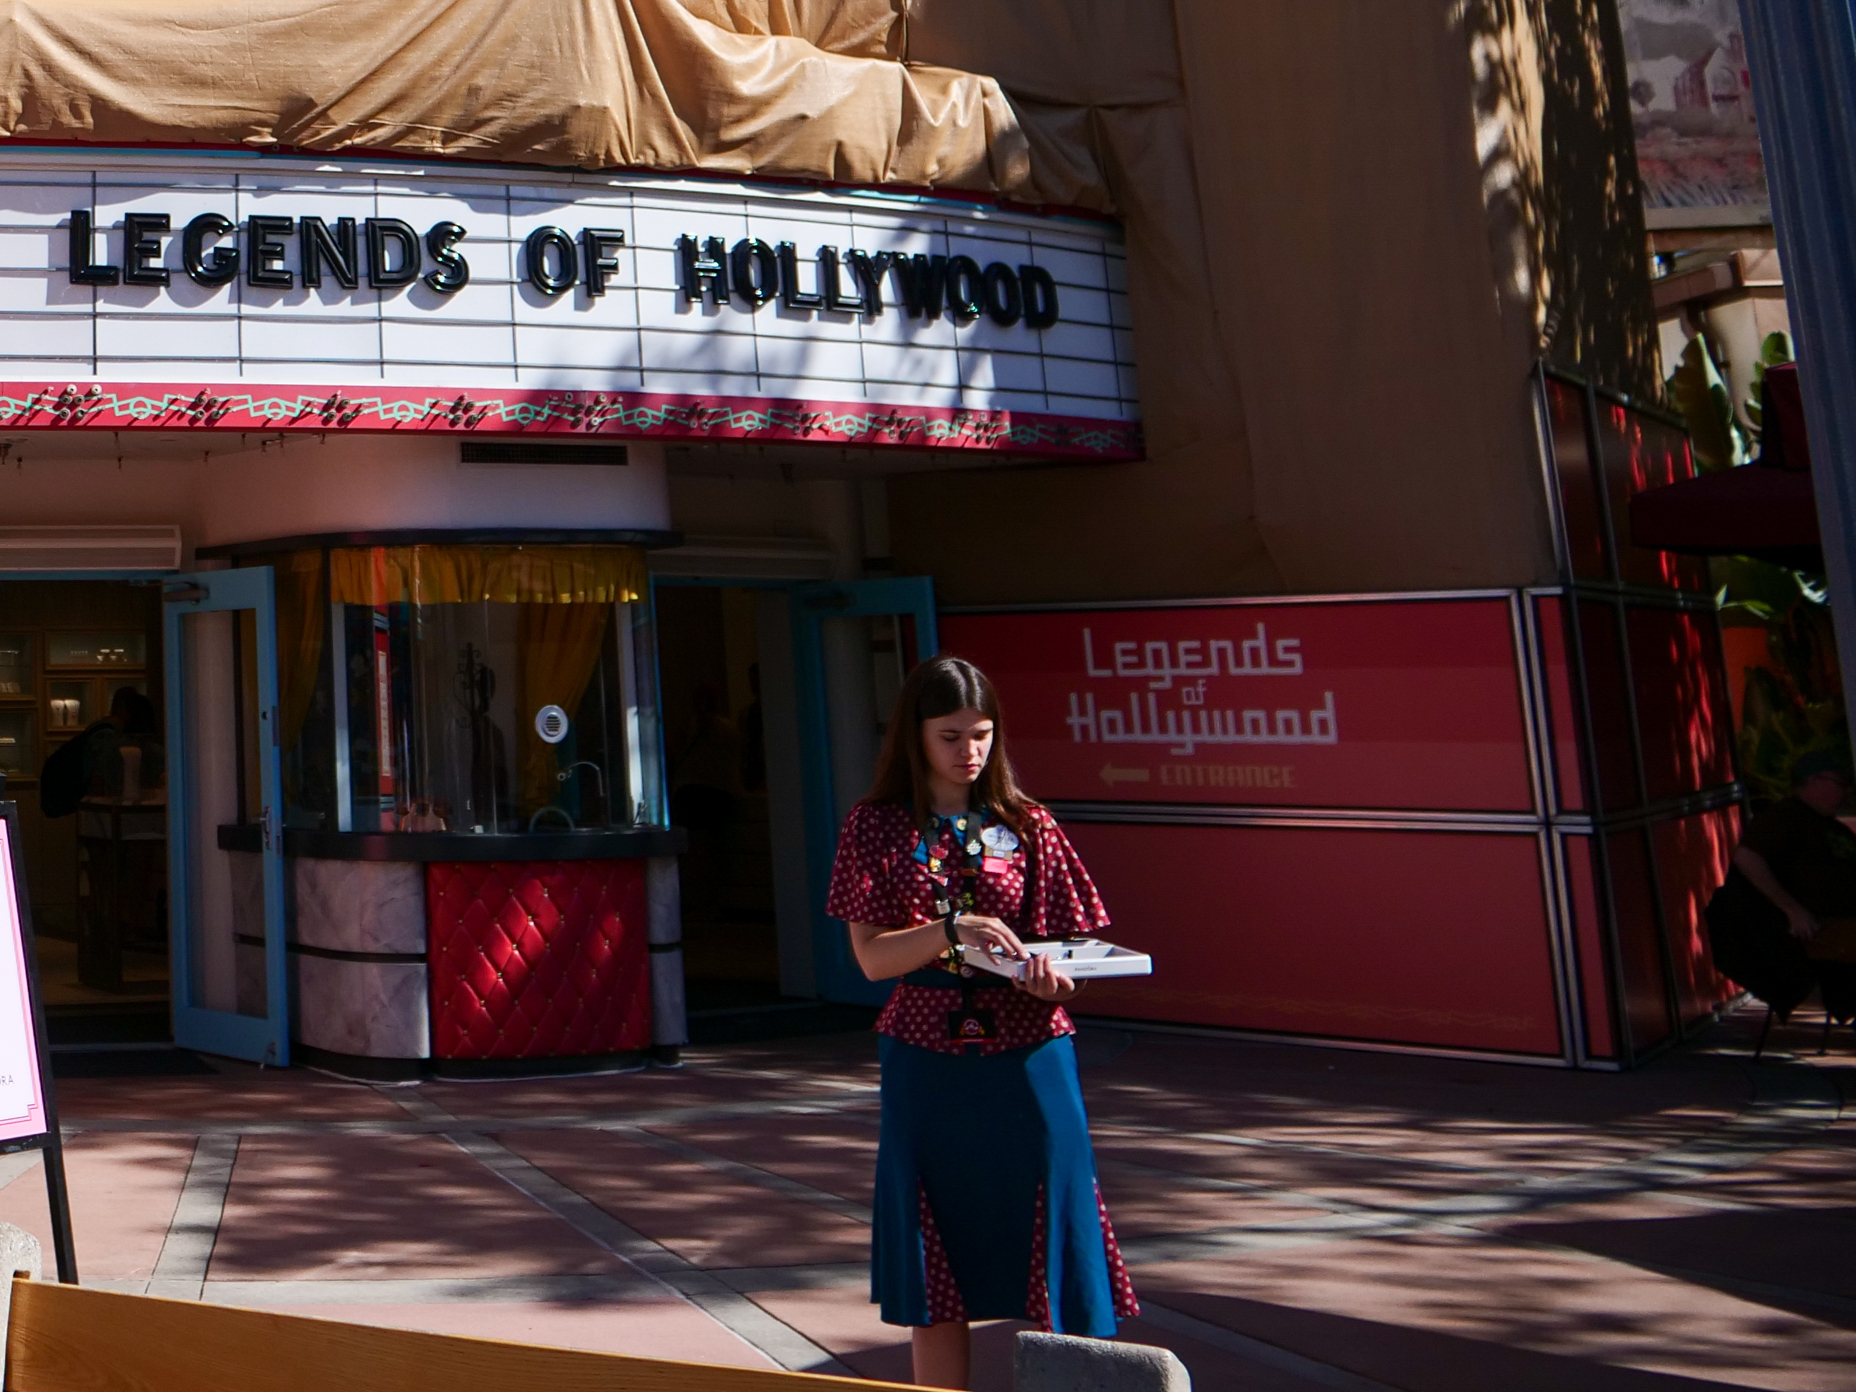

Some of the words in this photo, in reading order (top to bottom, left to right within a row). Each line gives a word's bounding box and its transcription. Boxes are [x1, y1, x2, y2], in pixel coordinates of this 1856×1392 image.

[69, 210, 470, 294] LEGENDS
[526, 225, 624, 298] OF
[681, 232, 1059, 330] HOLLYWOOD
[1083, 622, 1304, 690] Legends
[1066, 691, 1338, 755] Hollywood
[1182, 679, 1207, 705] of
[1160, 764, 1297, 788] ENTRANCE
